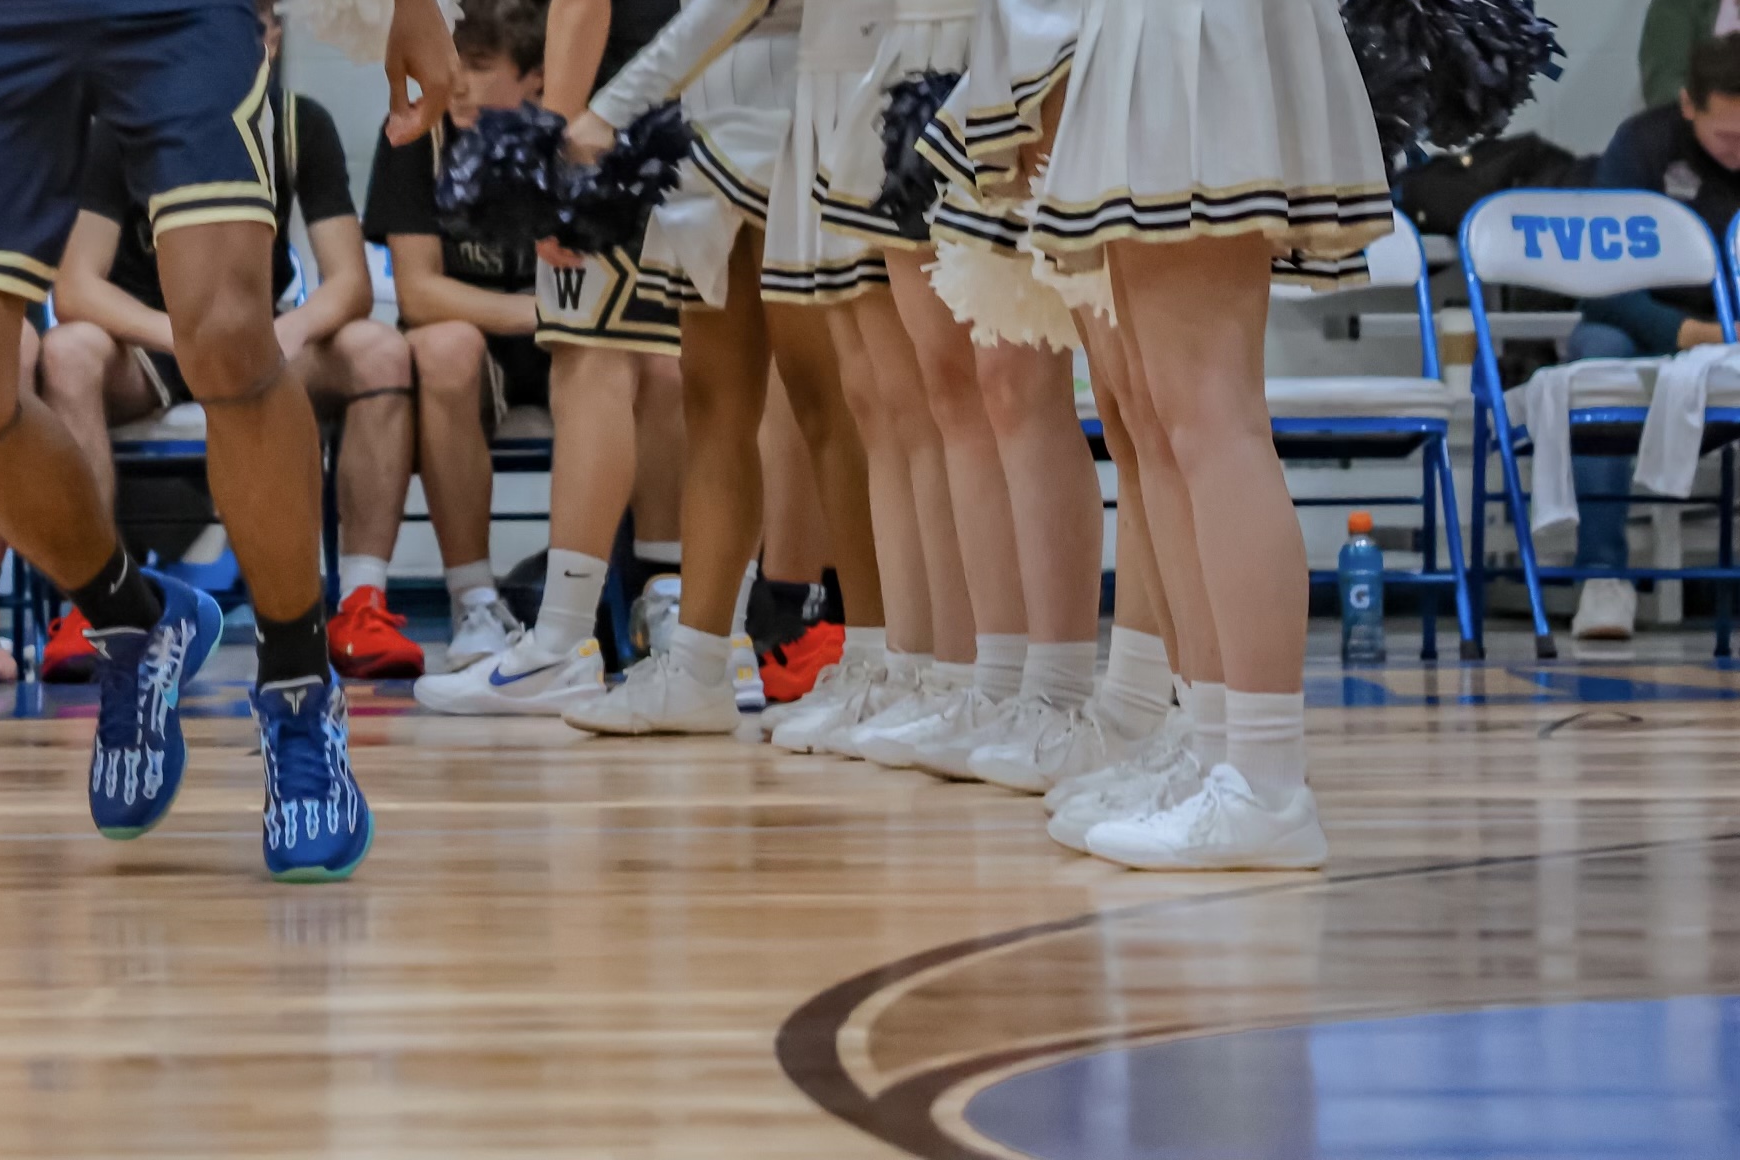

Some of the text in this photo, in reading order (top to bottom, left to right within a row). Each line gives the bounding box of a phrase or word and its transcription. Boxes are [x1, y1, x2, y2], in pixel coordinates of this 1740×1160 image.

[1511, 215, 1661, 261] TVCS
[552, 267, 586, 310] W
[1349, 583, 1371, 609] G
